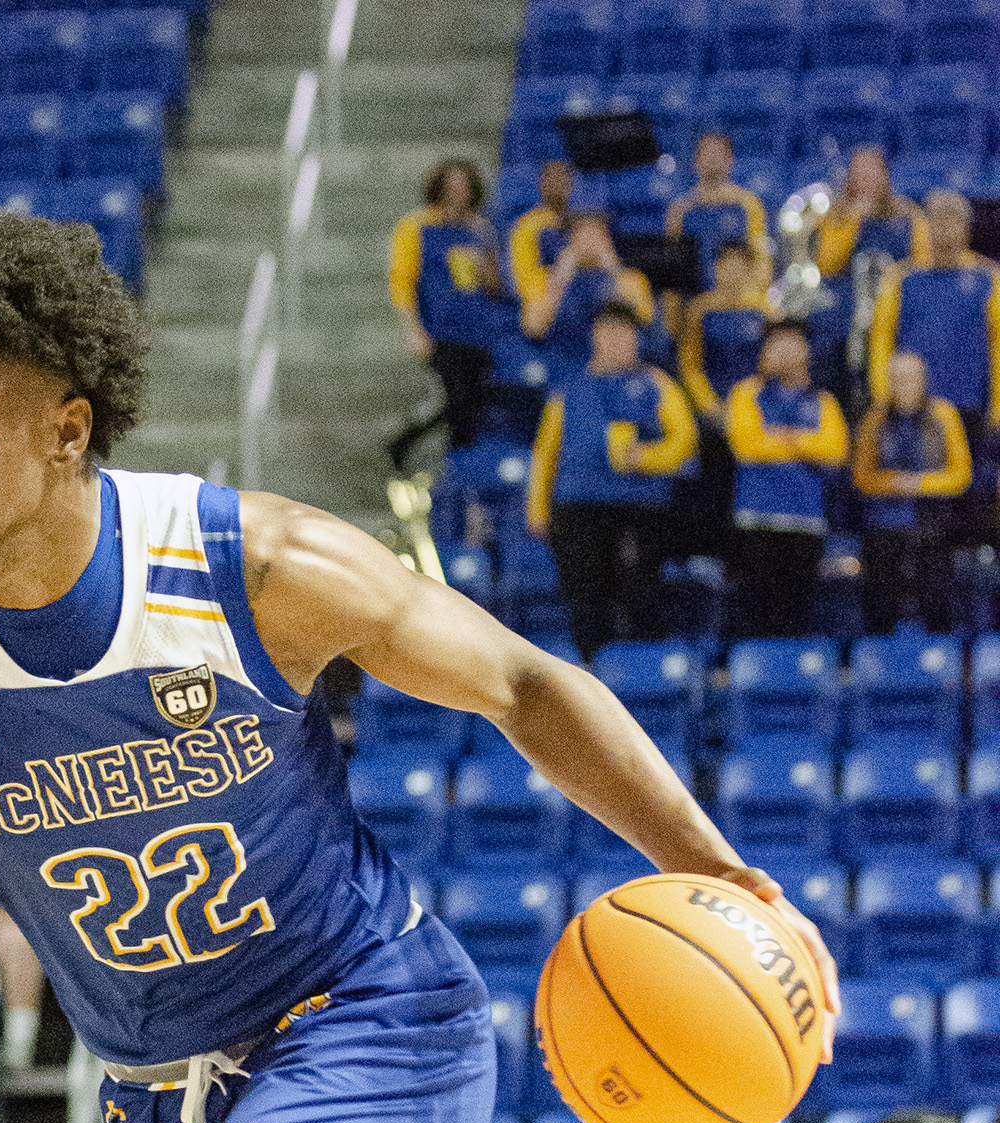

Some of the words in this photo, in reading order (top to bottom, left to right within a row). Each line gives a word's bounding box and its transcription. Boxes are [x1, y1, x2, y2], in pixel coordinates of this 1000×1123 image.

[165, 684, 208, 715] 60
[39, 821, 276, 973] 22
[688, 888, 817, 1045] Wilson
